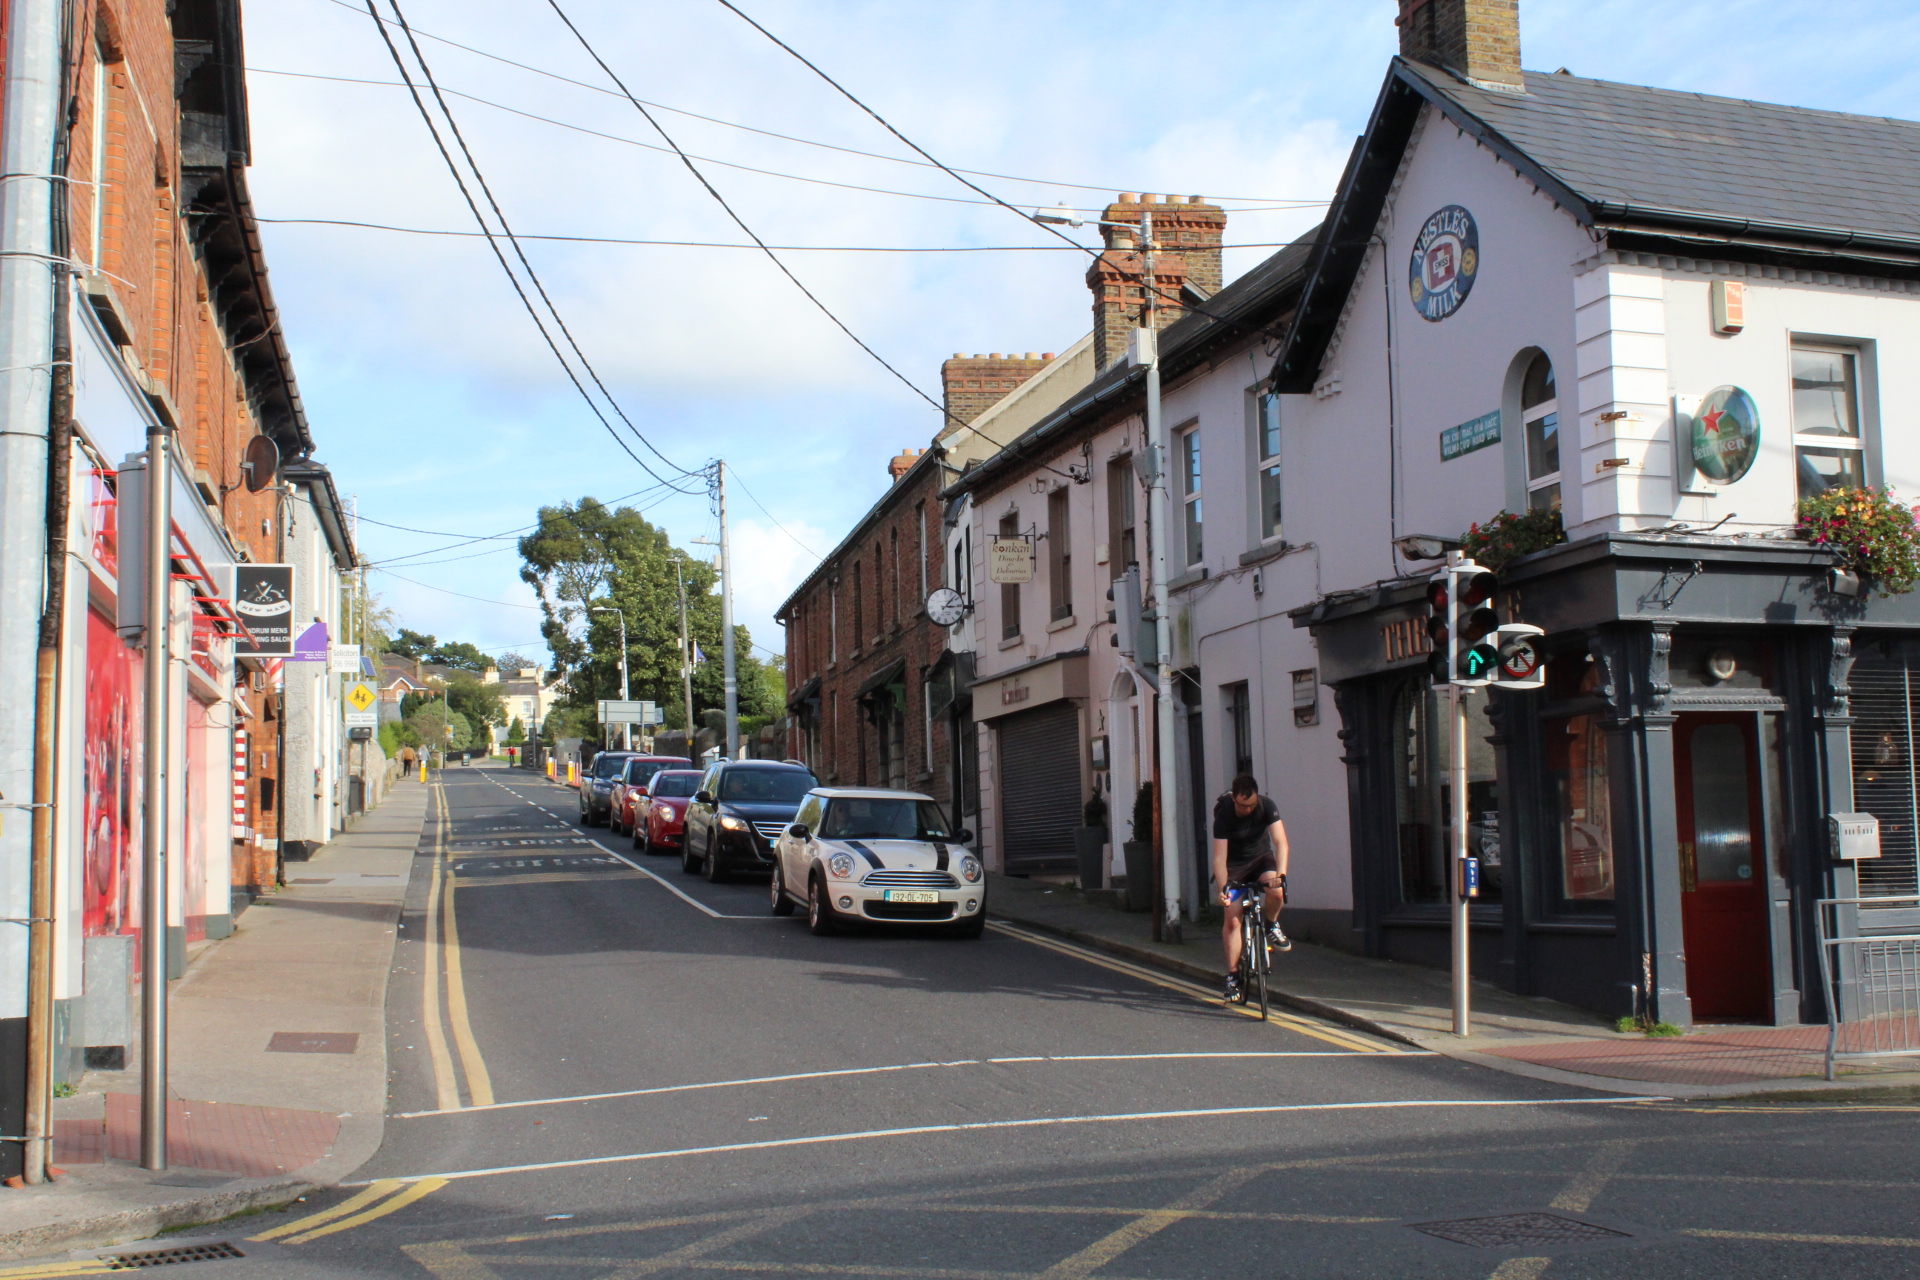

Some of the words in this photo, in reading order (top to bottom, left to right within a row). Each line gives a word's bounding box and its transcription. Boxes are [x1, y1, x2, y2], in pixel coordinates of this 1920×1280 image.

[1427, 281, 1462, 317] MILK
[242, 605, 262, 613] NEW
[1380, 613, 1431, 664] THE
[332, 649, 359, 657] Solicitors
[892, 893, 934, 903] 132-DL-705
